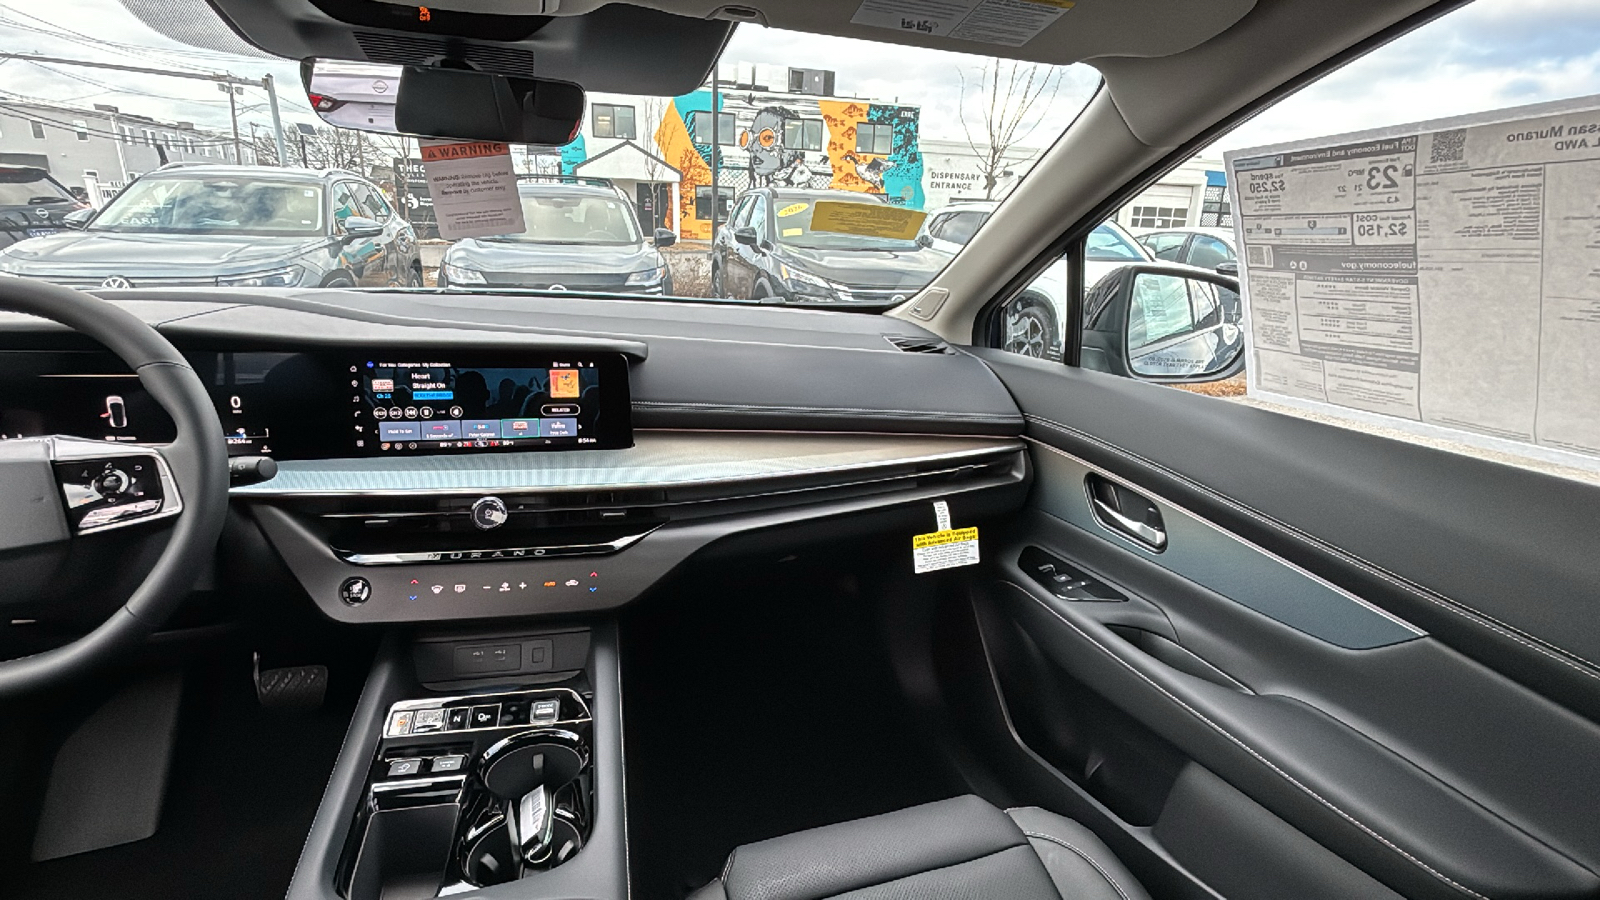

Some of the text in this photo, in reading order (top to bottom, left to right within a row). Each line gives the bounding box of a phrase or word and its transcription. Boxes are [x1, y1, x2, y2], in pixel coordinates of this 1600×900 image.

[438, 144, 503, 158] WARNING
[931, 172, 980, 180] DISPENSARY
[930, 182, 972, 190] ENTRANCE
[231, 396, 240, 408] 0
[952, 529, 975, 537] Equipped
[928, 538, 952, 546] Advanced
[428, 549, 546, 560] MURANO
